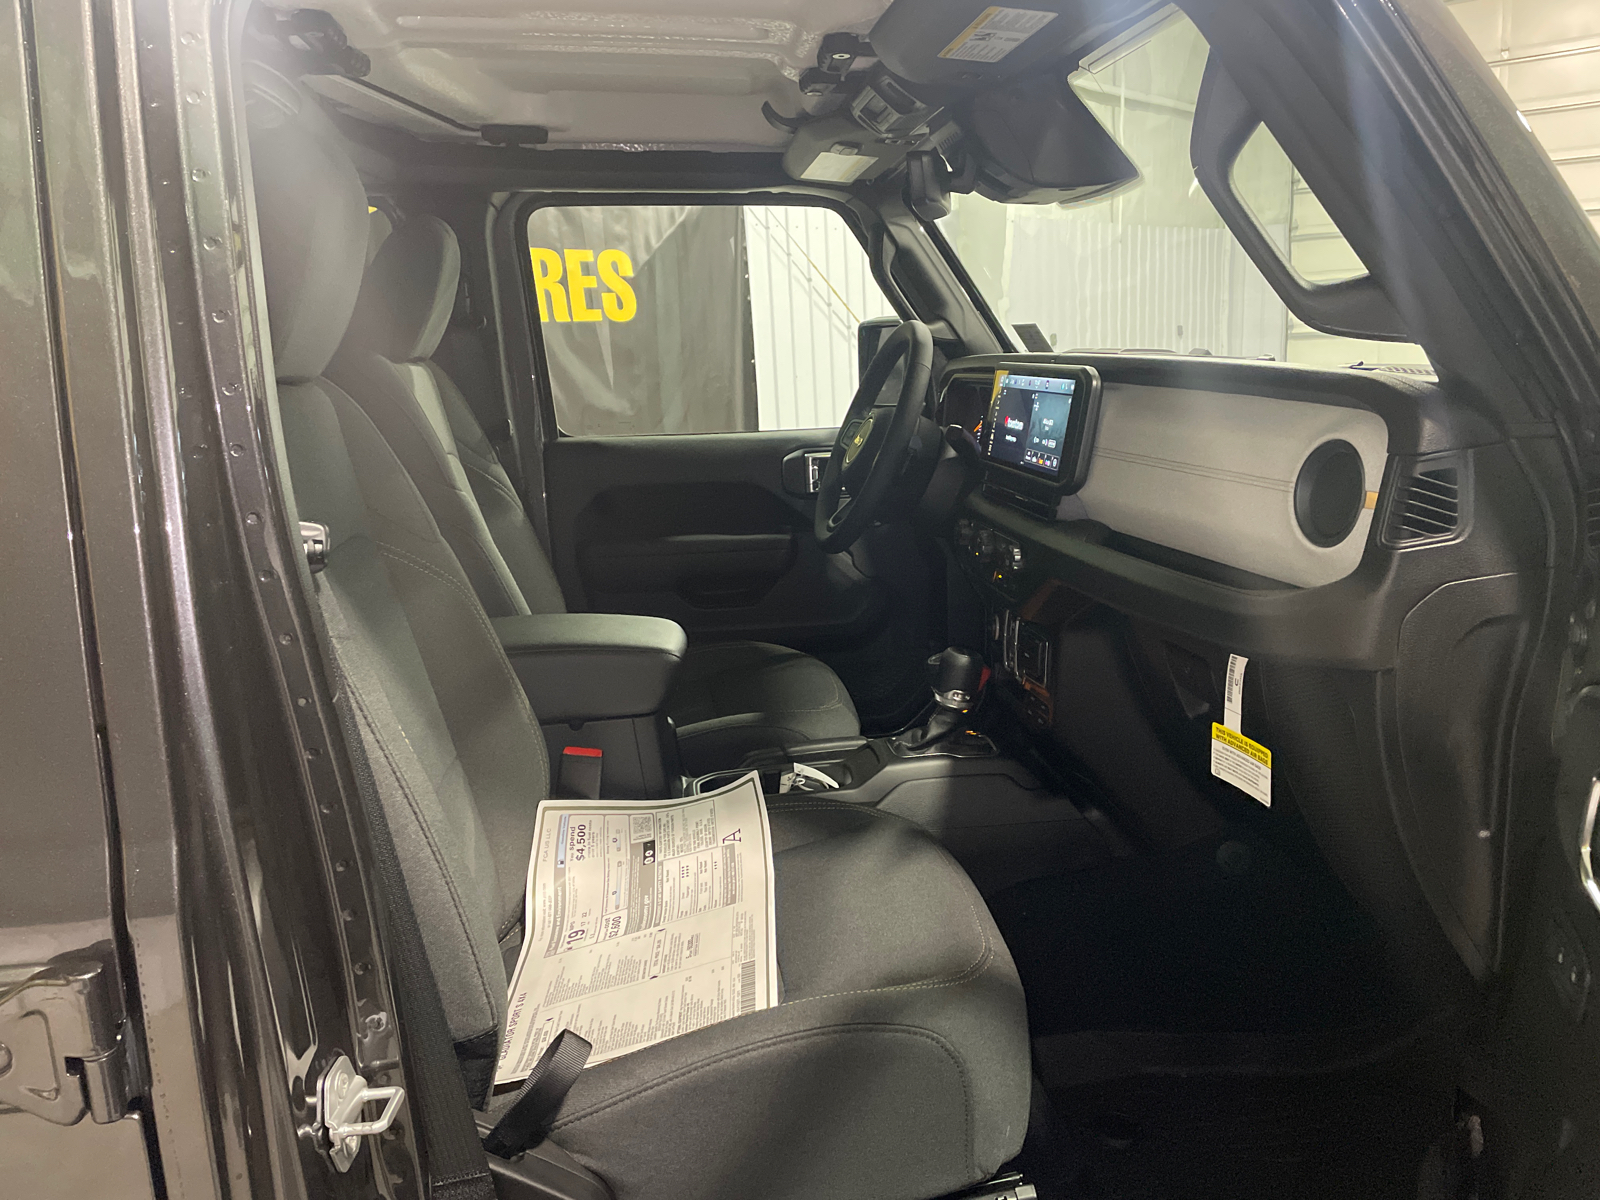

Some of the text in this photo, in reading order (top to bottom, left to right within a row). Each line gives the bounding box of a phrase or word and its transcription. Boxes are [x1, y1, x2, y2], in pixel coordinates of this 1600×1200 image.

[530, 247, 637, 322] RES
[1215, 727, 1226, 736] THIS
[1226, 732, 1244, 745] VEHICLE
[1248, 742, 1268, 759] EQUIPPED
[1215, 734, 1227, 742] WITH
[1227, 739, 1250, 754] ADVANCED
[1257, 754, 1269, 765] BAGS
[544, 840, 550, 849] US
[568, 826, 576, 851] spend
[575, 824, 587, 862] $4,500
[566, 929, 586, 945] 19
[608, 915, 622, 939] $2,600
[499, 1026, 516, 1061] GLADIATOR
[508, 1008, 523, 1028] SPORT
